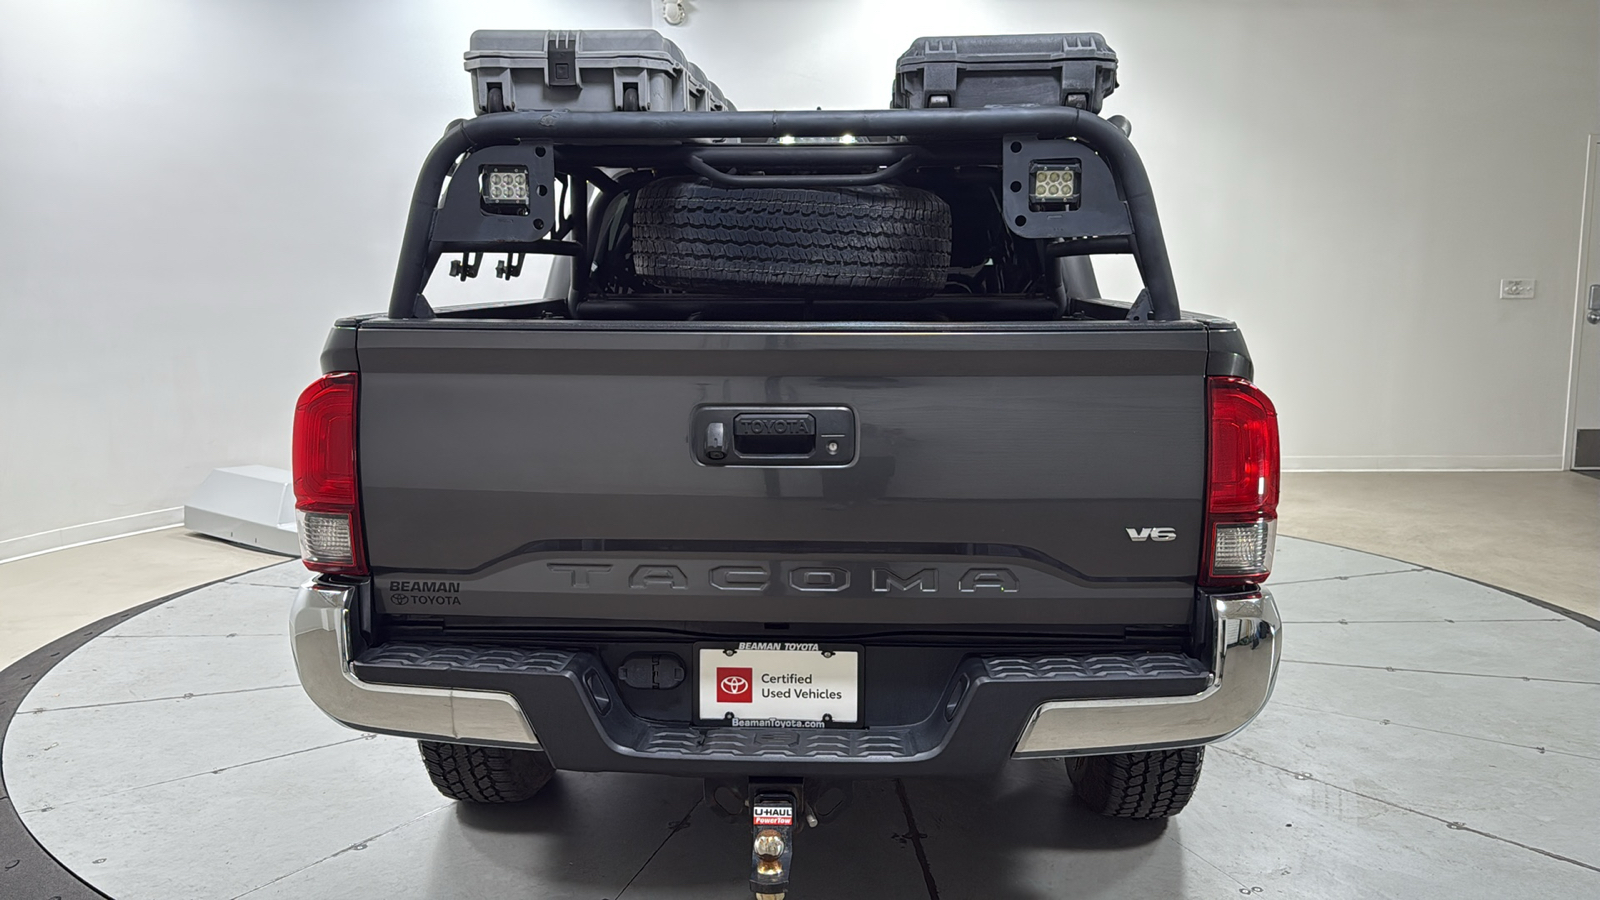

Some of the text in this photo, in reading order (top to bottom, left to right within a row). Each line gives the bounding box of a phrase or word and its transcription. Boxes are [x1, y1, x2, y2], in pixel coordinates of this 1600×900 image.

[741, 419, 809, 434] TOYOTA
[1125, 527, 1177, 542] V6
[547, 562, 1020, 592] TACOMA
[389, 581, 460, 593] BEAMAN
[410, 595, 461, 605] TOYOTA
[738, 642, 819, 651] BEAMAN TOYOTA
[761, 673, 813, 684] Certified
[761, 688, 842, 700] Used Vehicles
[732, 718, 825, 729] BeamanToyota.com
